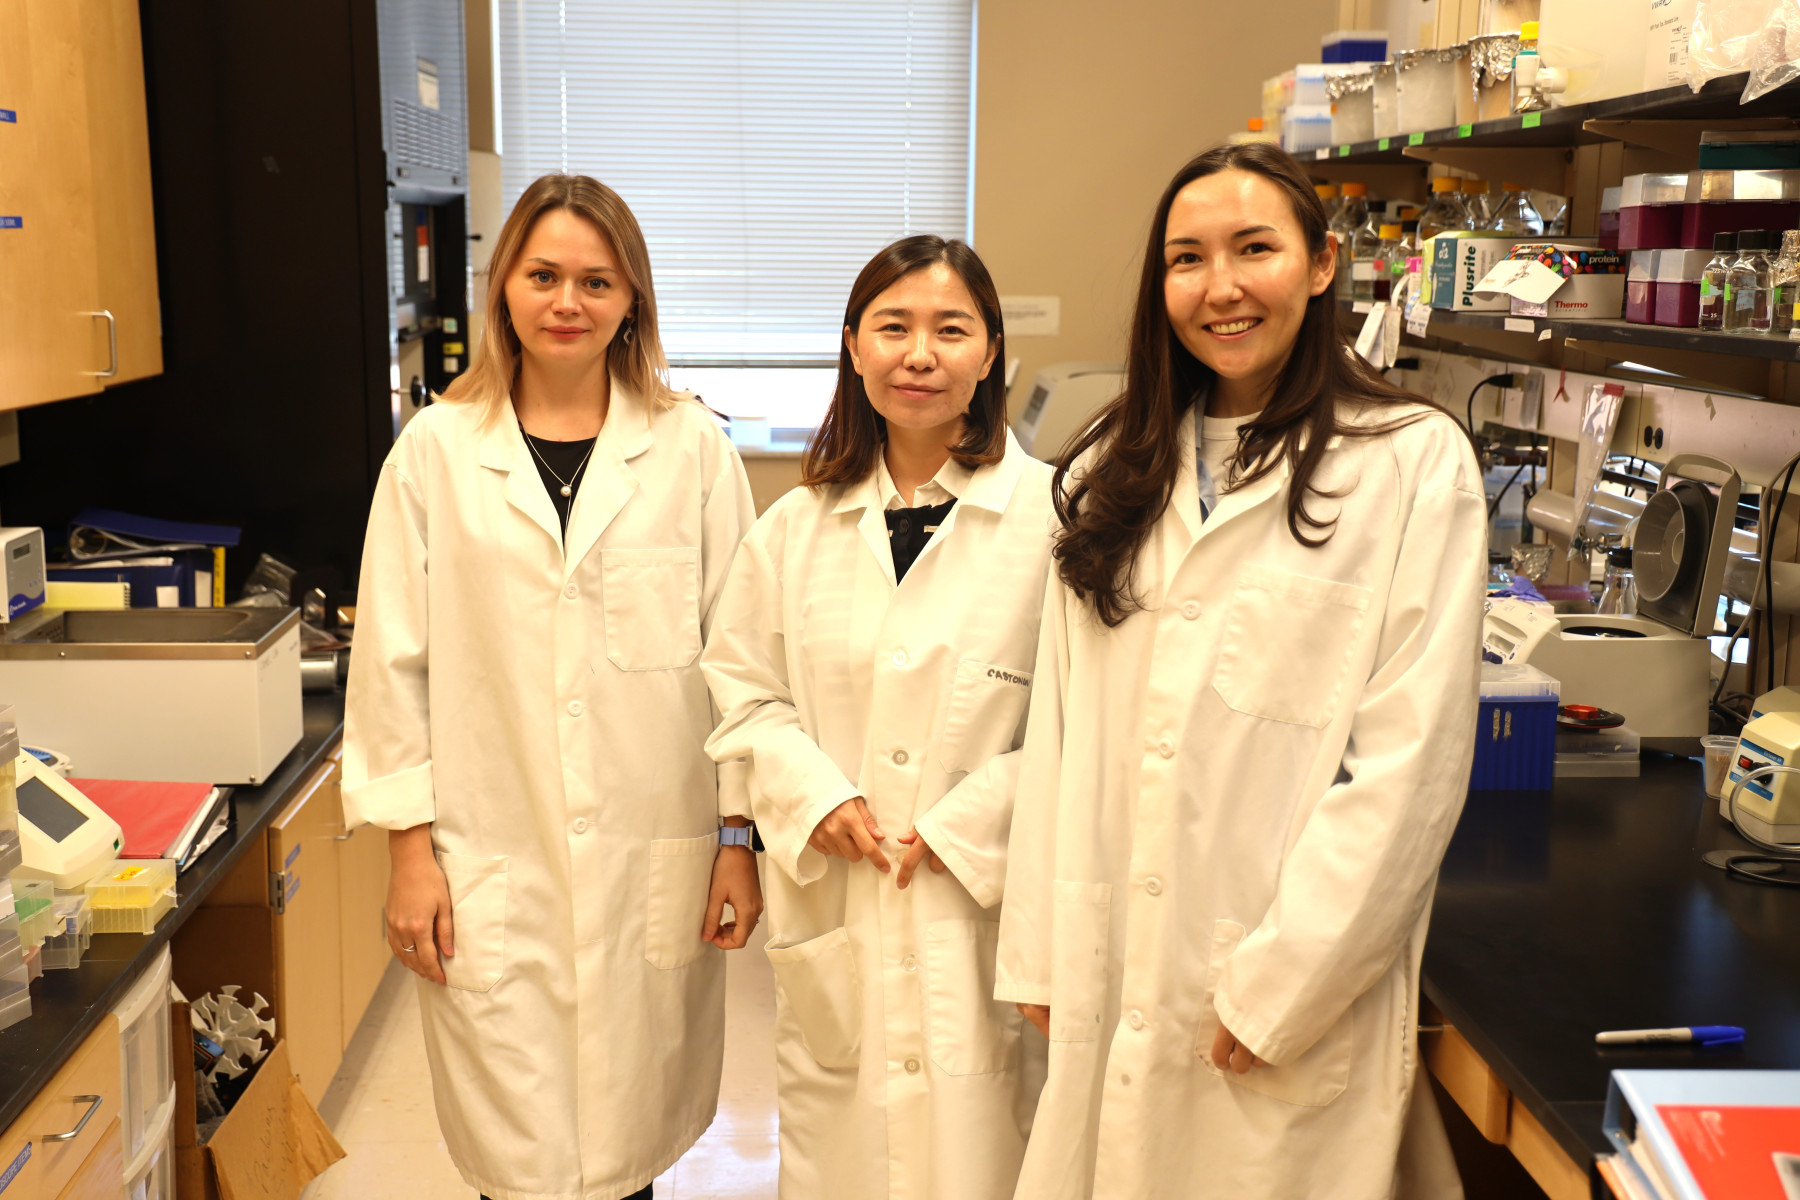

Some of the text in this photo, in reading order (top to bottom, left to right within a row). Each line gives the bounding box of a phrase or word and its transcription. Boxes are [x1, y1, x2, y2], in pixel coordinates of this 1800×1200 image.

[1589, 255, 1619, 264] protein
[1462, 246, 1476, 306] Plusrite
[1555, 300, 1588, 308] Thermo
